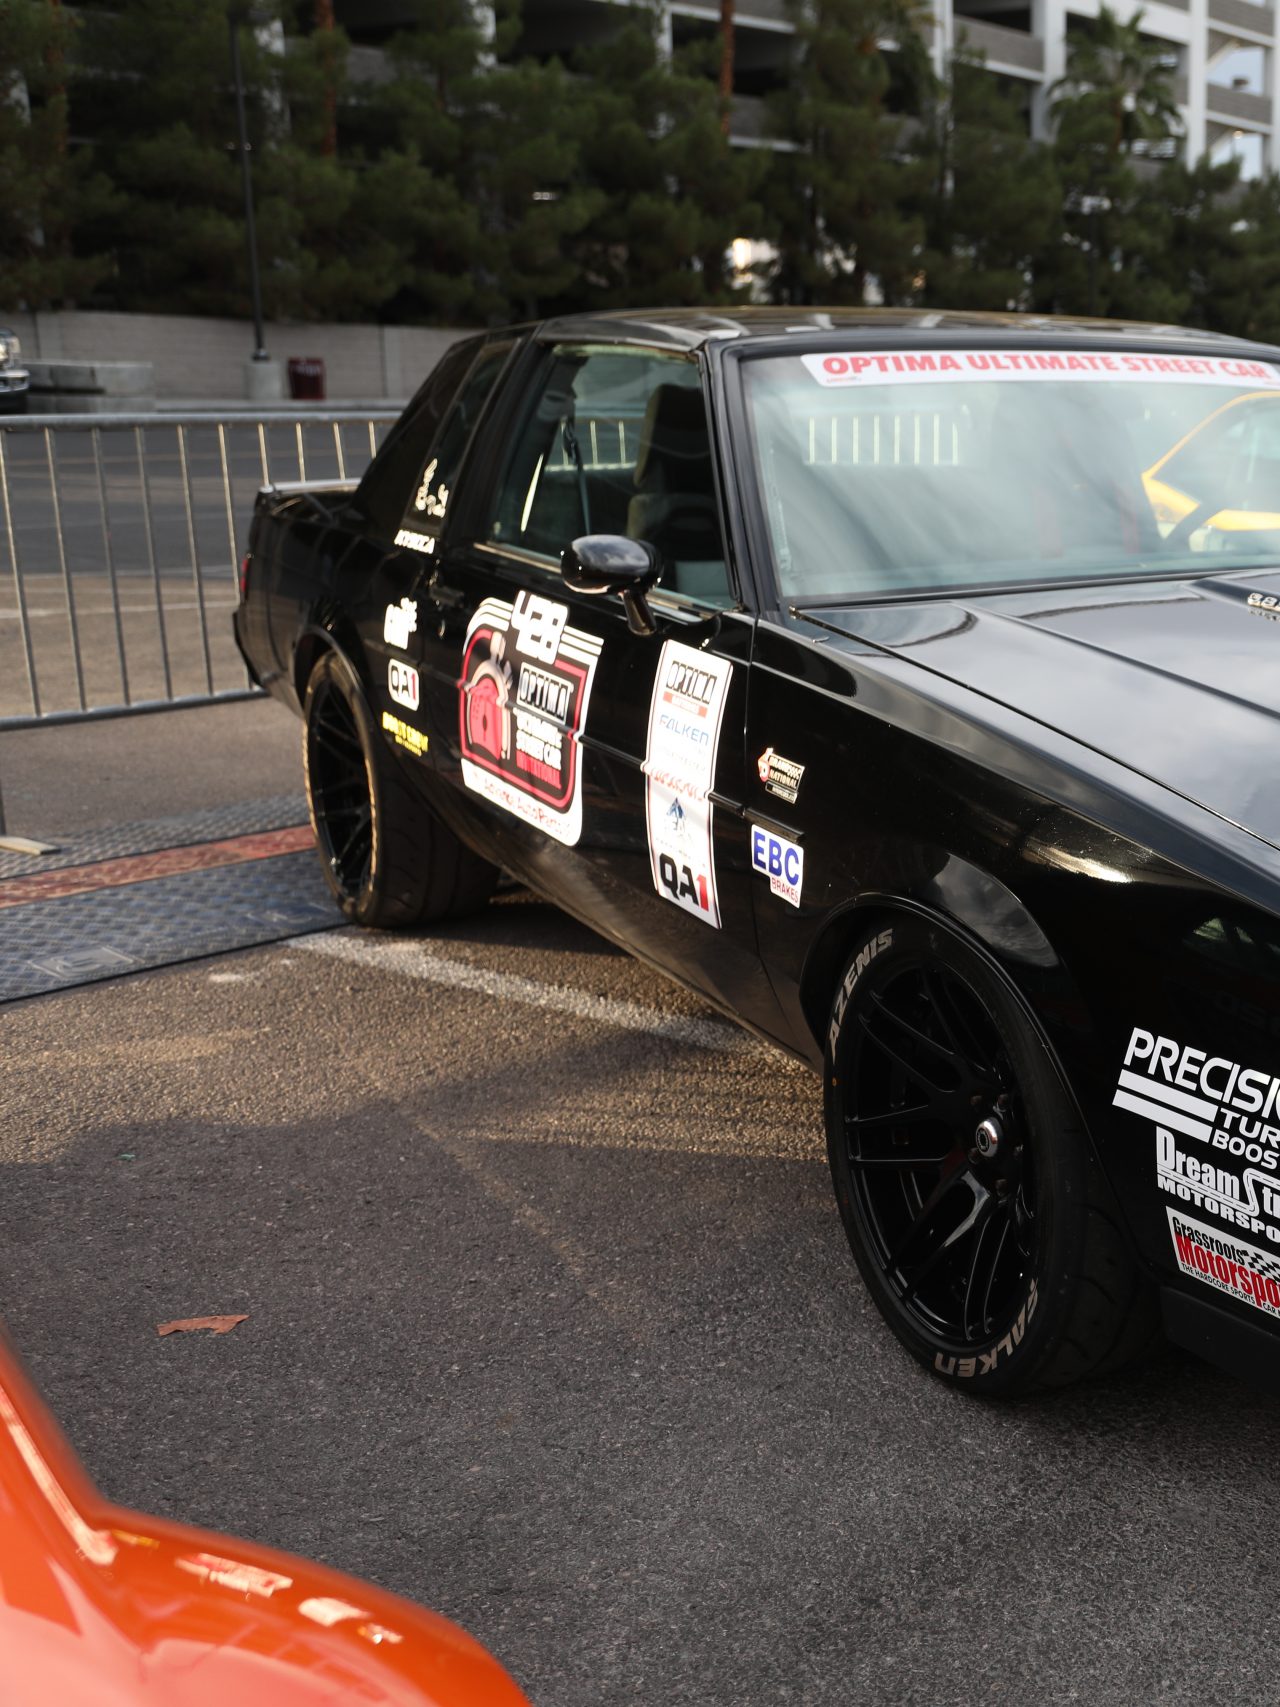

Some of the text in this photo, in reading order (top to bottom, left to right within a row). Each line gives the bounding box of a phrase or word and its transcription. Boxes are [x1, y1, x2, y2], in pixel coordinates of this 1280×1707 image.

[823, 354, 1272, 380] OPTIMA ULTIMATE STREET CAR
[511, 590, 568, 665] 428
[391, 665, 417, 701] QA1
[519, 668, 568, 720] OPTIMA
[666, 660, 717, 704] OPTIMA
[659, 714, 709, 746] FALKEN
[769, 769, 797, 789] NATIONAL
[660, 853, 709, 912] QA1
[753, 830, 799, 886] EBC
[771, 877, 798, 904] BRAKES
[829, 928, 894, 1065] AZENIS
[1156, 1126, 1240, 1201] Dream
[1172, 1216, 1245, 1265] Grassroots
[1181, 1262, 1194, 1275] THE
[1194, 1270, 1229, 1292] HARDCORE
[1230, 1286, 1256, 1305] SPORTS
[1262, 1302, 1277, 1316] CAR
[934, 1278, 1039, 1378] FALKEN
